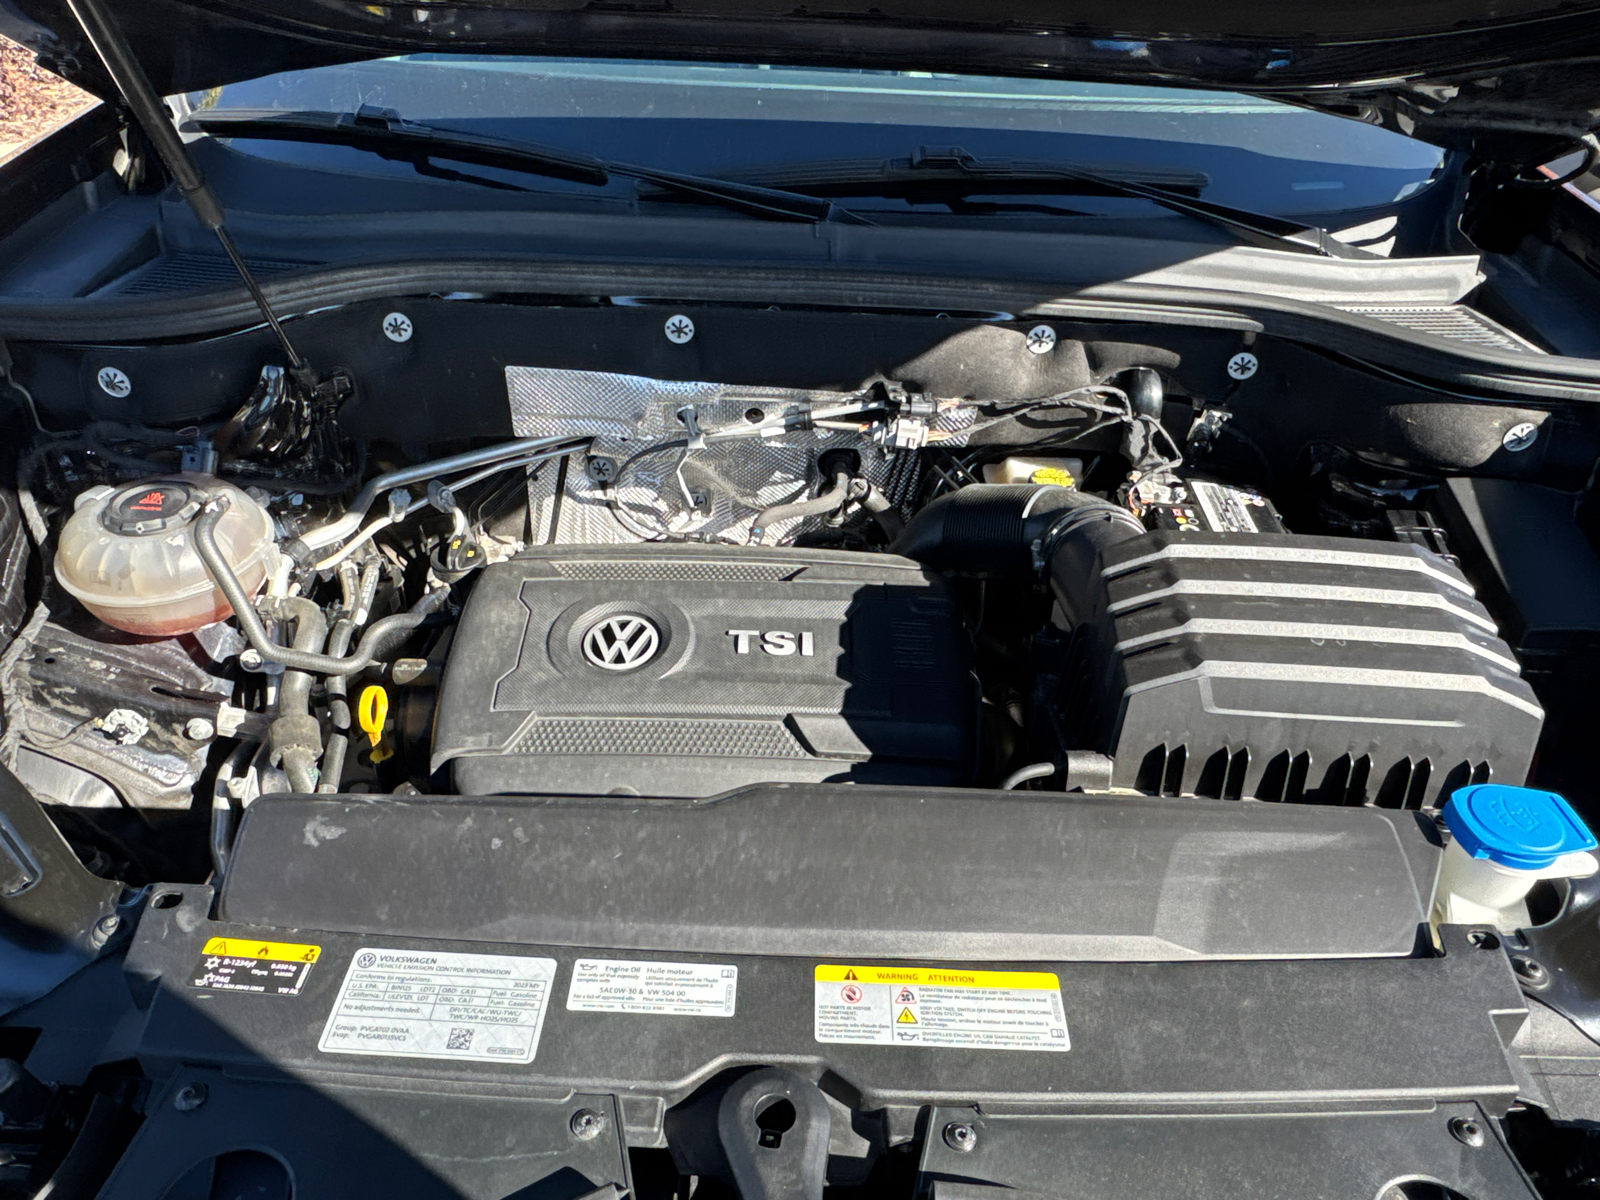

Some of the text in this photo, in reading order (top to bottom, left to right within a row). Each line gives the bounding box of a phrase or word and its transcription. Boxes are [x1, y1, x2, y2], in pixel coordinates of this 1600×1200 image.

[726, 629, 816, 656] TSI
[380, 955, 438, 965] VOLKSWAGEN
[605, 965, 629, 974] Engine
[876, 972, 975, 984] WARNING ATTENTION
[354, 1004, 394, 1012] adjustments
